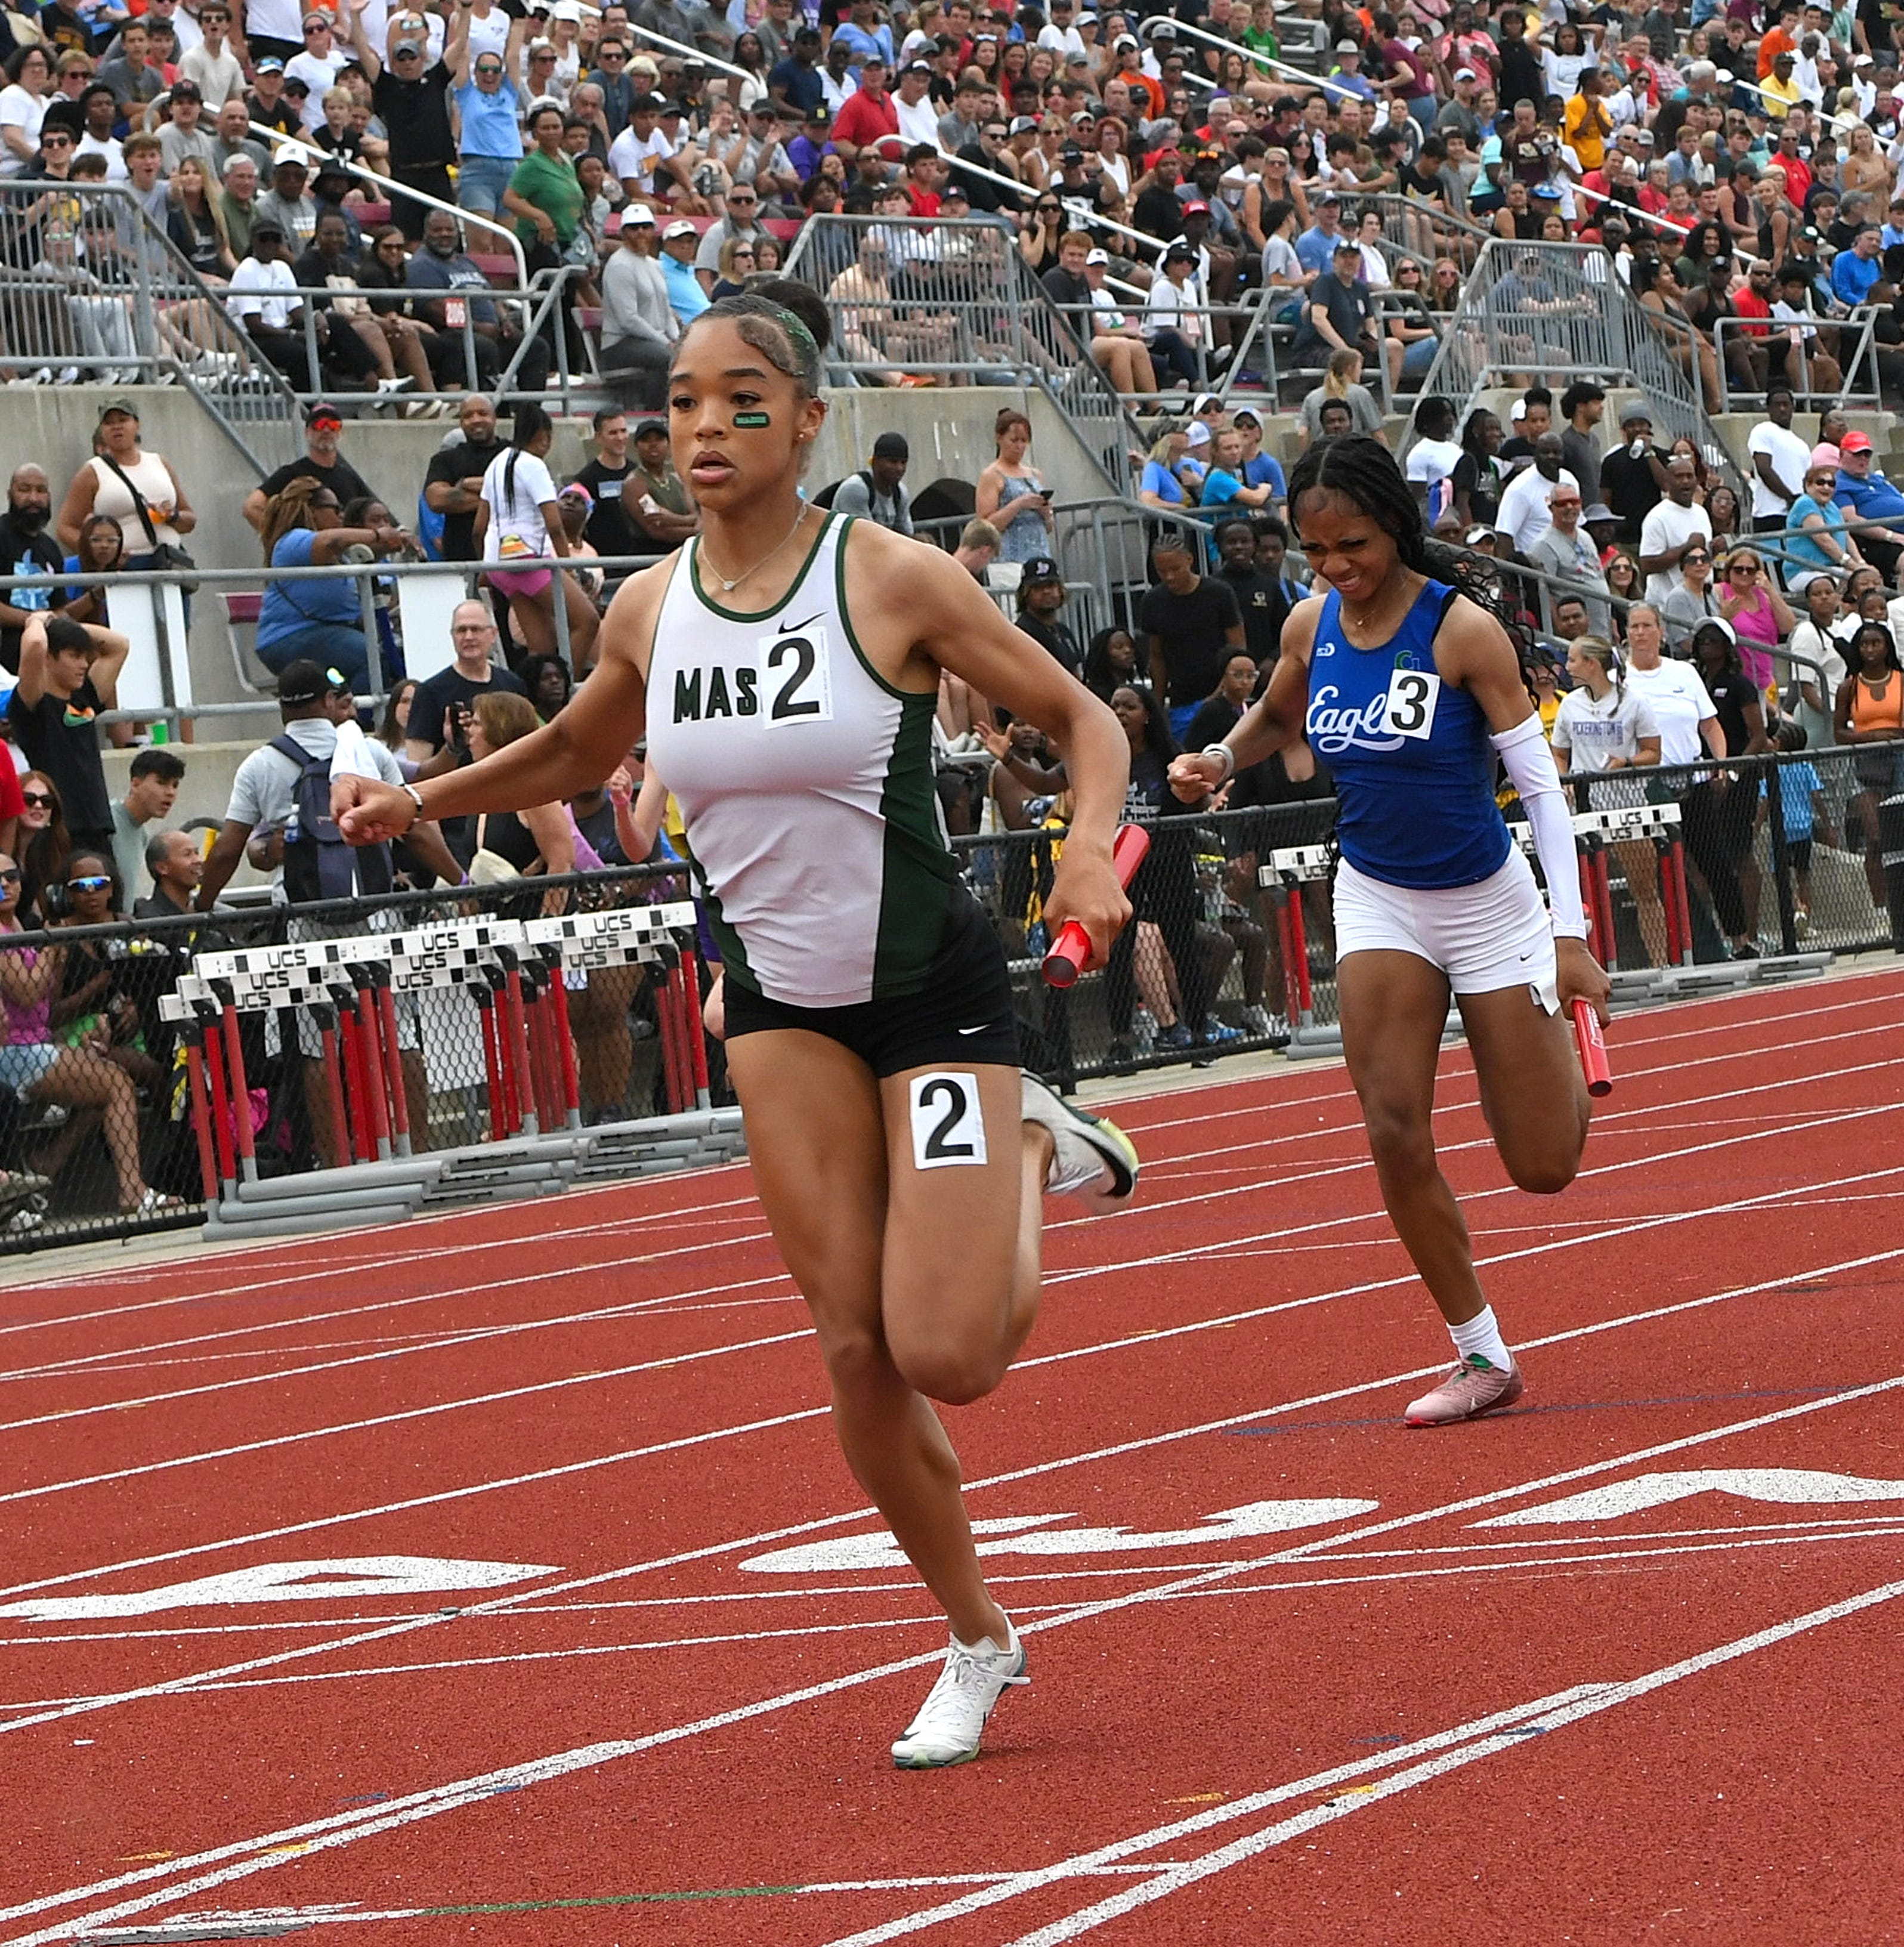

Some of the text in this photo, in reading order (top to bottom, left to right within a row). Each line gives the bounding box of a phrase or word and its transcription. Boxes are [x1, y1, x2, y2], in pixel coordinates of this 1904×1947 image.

[768, 637, 820, 720] 2
[673, 666, 764, 724] MAS
[1391, 675, 1429, 731] 3
[1306, 685, 1406, 753] Eagl
[1619, 811, 1642, 826] UCS
[1610, 827, 1632, 840] UCS
[594, 914, 632, 933] UCS
[422, 932, 459, 951] UCS
[580, 934, 619, 950] UCS
[268, 949, 307, 969] UCS
[409, 952, 447, 971] UCS
[570, 951, 607, 968] UCS
[250, 970, 289, 990] UCS
[396, 971, 434, 990] UCS
[919, 1078, 975, 1160] 2
